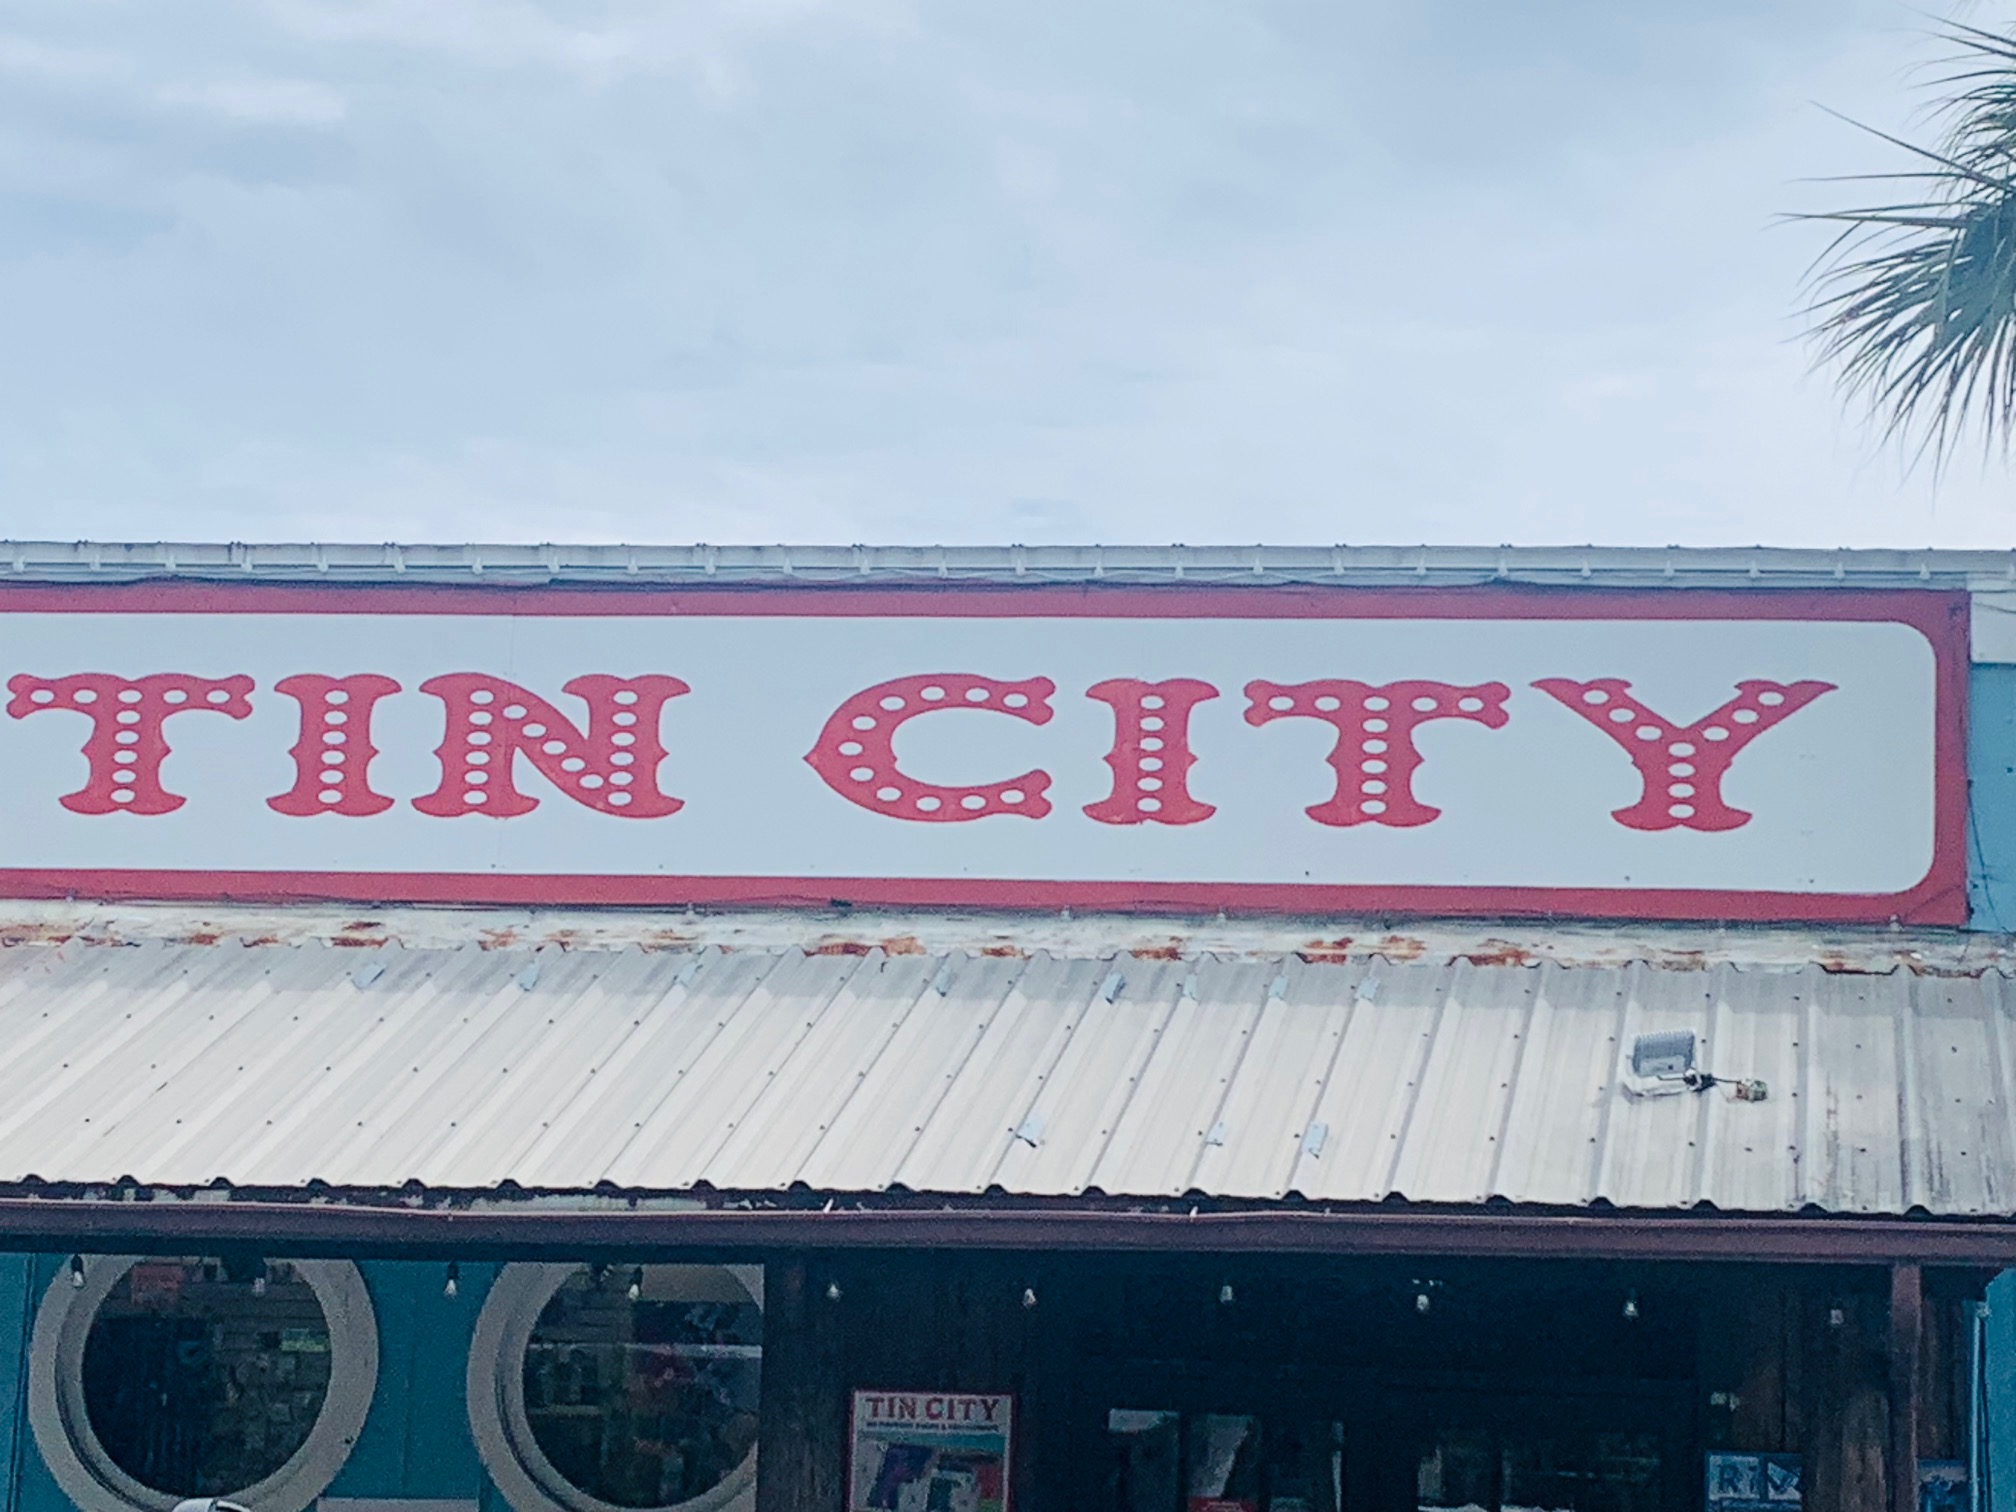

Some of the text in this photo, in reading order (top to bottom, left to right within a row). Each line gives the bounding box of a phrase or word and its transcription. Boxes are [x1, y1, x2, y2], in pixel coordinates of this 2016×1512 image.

[6, 672, 1838, 832] TIN CITY
[865, 1396, 1000, 1421] TIN CITY
